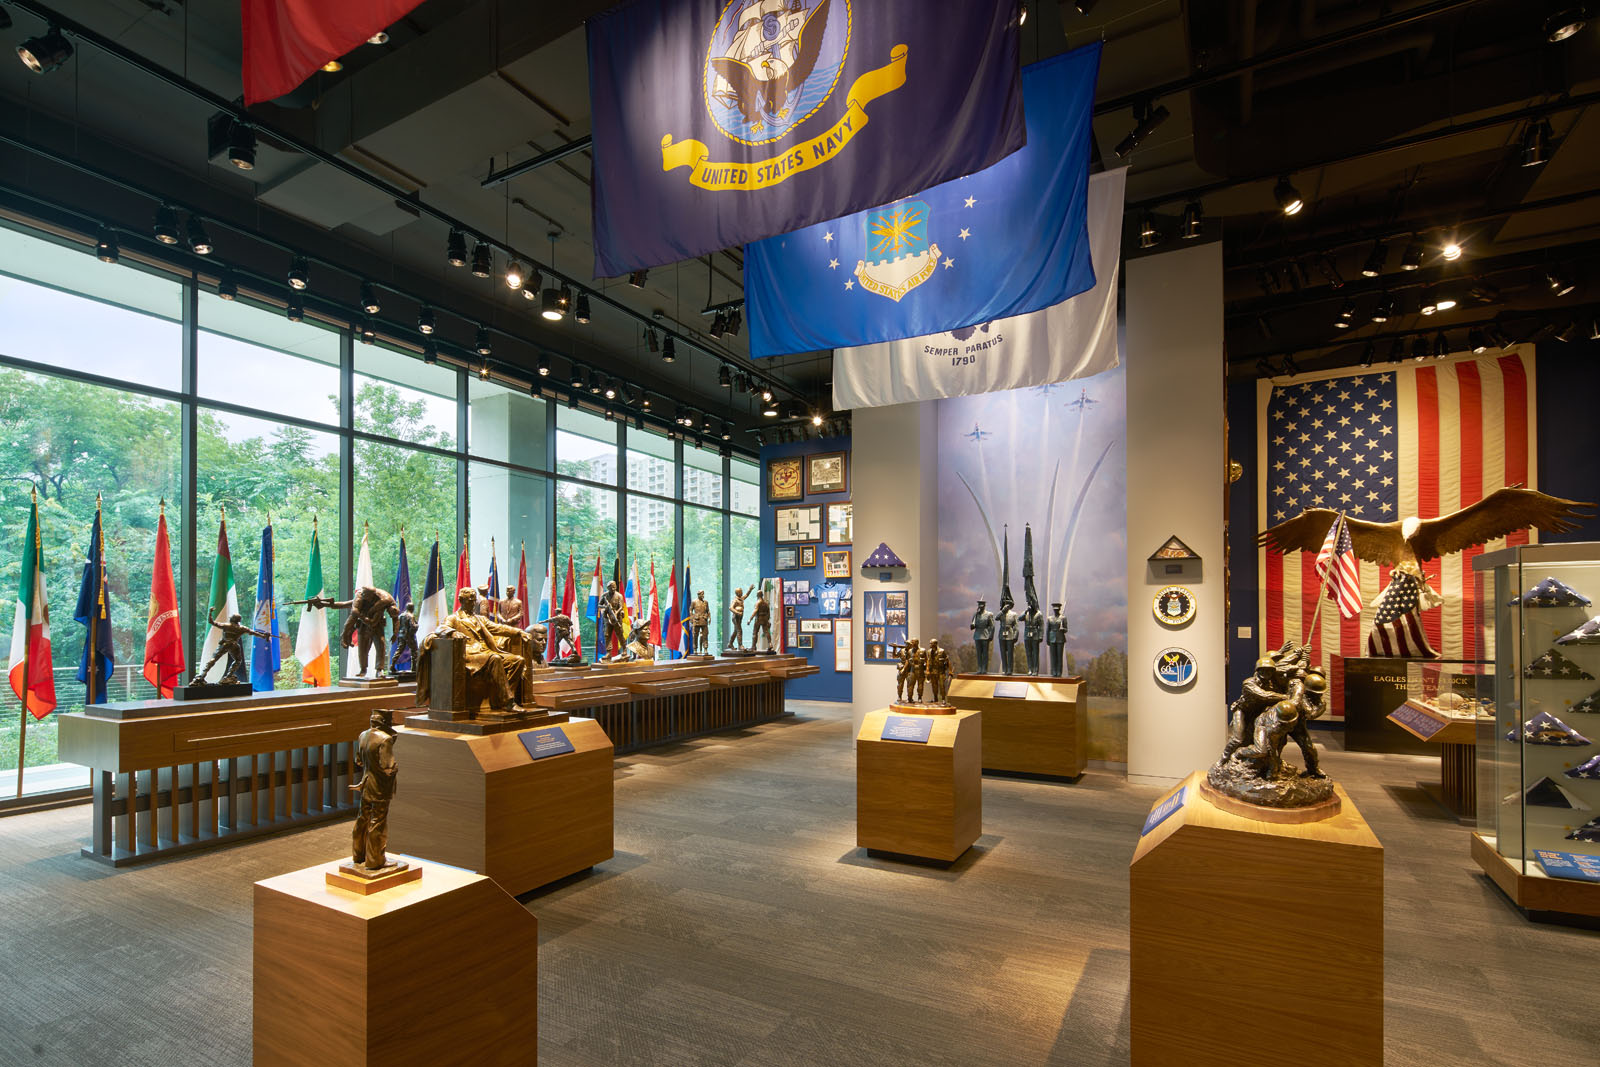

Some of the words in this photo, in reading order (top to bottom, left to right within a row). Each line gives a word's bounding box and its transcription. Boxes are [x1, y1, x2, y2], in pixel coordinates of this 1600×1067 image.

[701, 168, 748, 184] UNITED
[757, 150, 804, 183] STATES
[812, 116, 853, 160] NAVY
[860, 270, 879, 291] UNITED
[879, 284, 906, 299] STATES
[907, 276, 921, 289] AIR
[919, 258, 936, 280] FORCE
[924, 345, 958, 356] SEMPER
[965, 334, 1003, 354] PARATUS
[951, 355, 976, 366] 1790
[823, 599, 836, 611] 43
[1373, 675, 1407, 683] EAGLES
